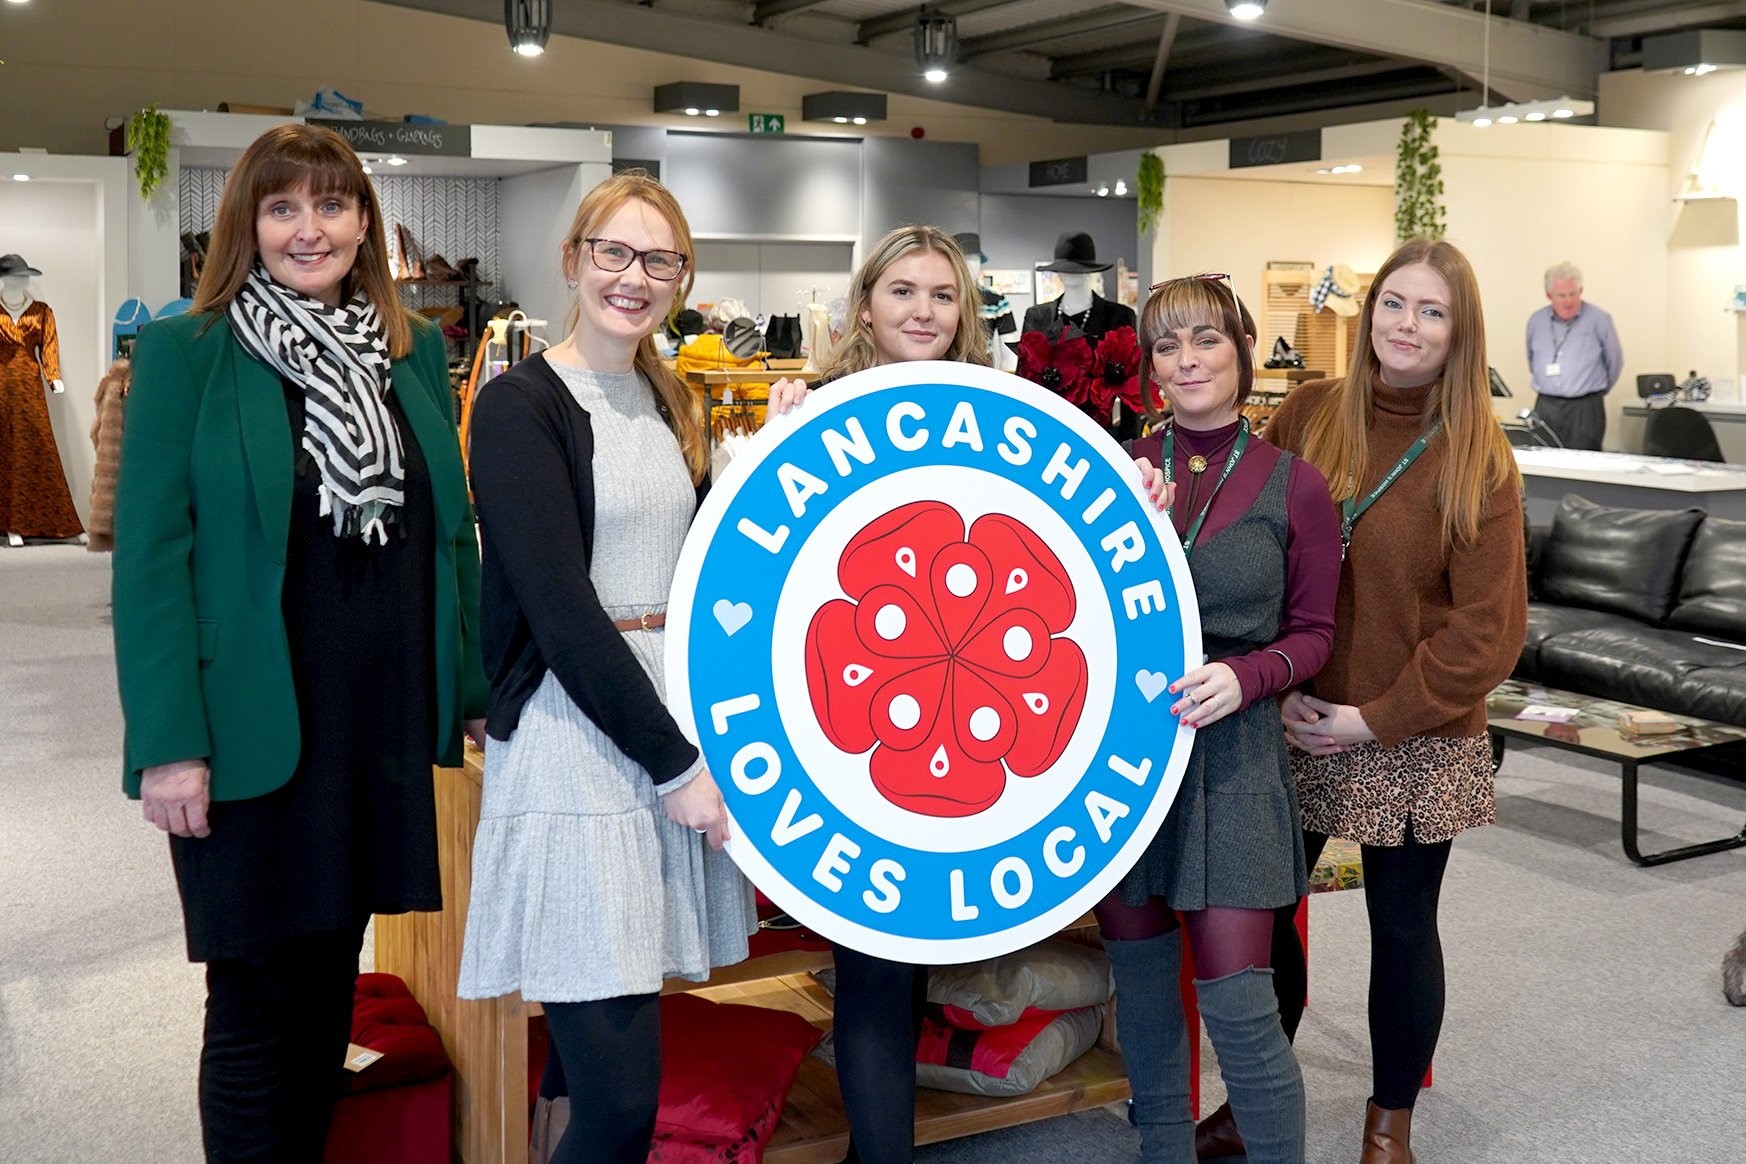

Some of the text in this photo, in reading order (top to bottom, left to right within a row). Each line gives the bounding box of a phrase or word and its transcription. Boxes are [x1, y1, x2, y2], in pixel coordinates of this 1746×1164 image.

[737, 401, 1166, 620] LANCASHIRE
[711, 693, 1152, 921] LOVES LOCAL
